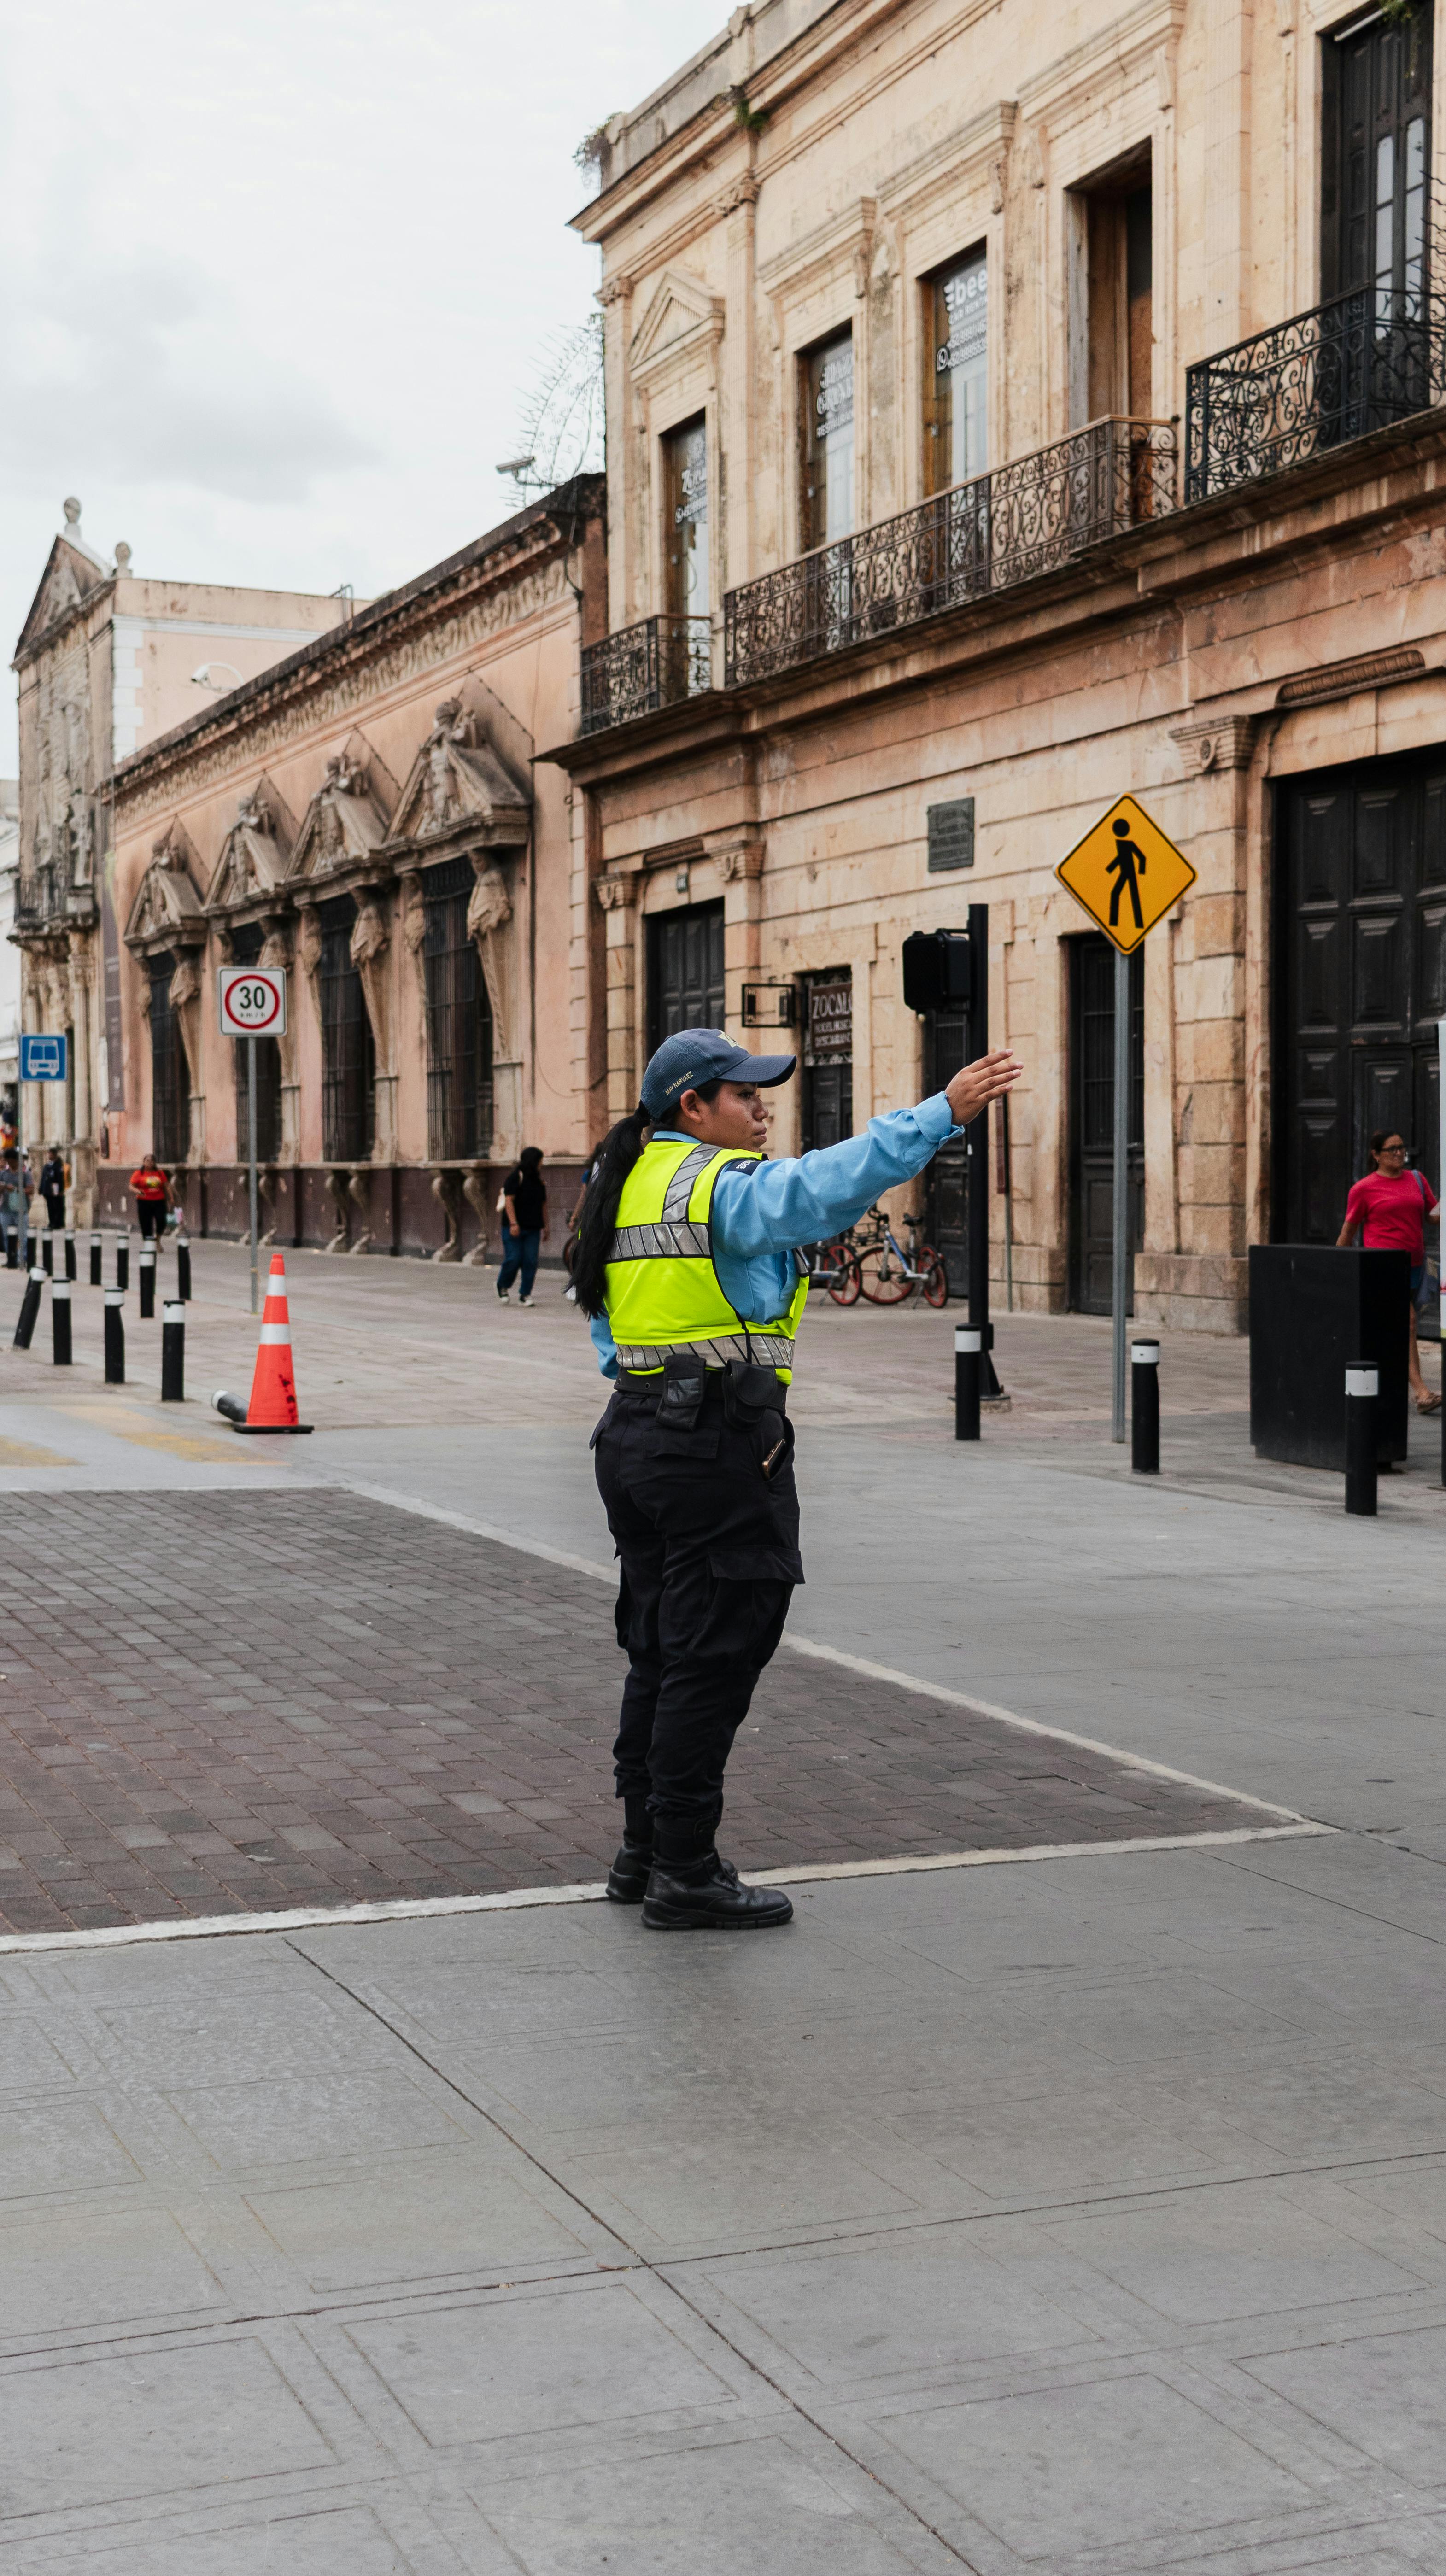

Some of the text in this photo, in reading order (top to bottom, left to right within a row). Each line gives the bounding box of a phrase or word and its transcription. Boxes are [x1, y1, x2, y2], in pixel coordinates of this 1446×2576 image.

[240, 985, 266, 1009] 30
[665, 1071, 693, 1095] MAY NARVAEZ
